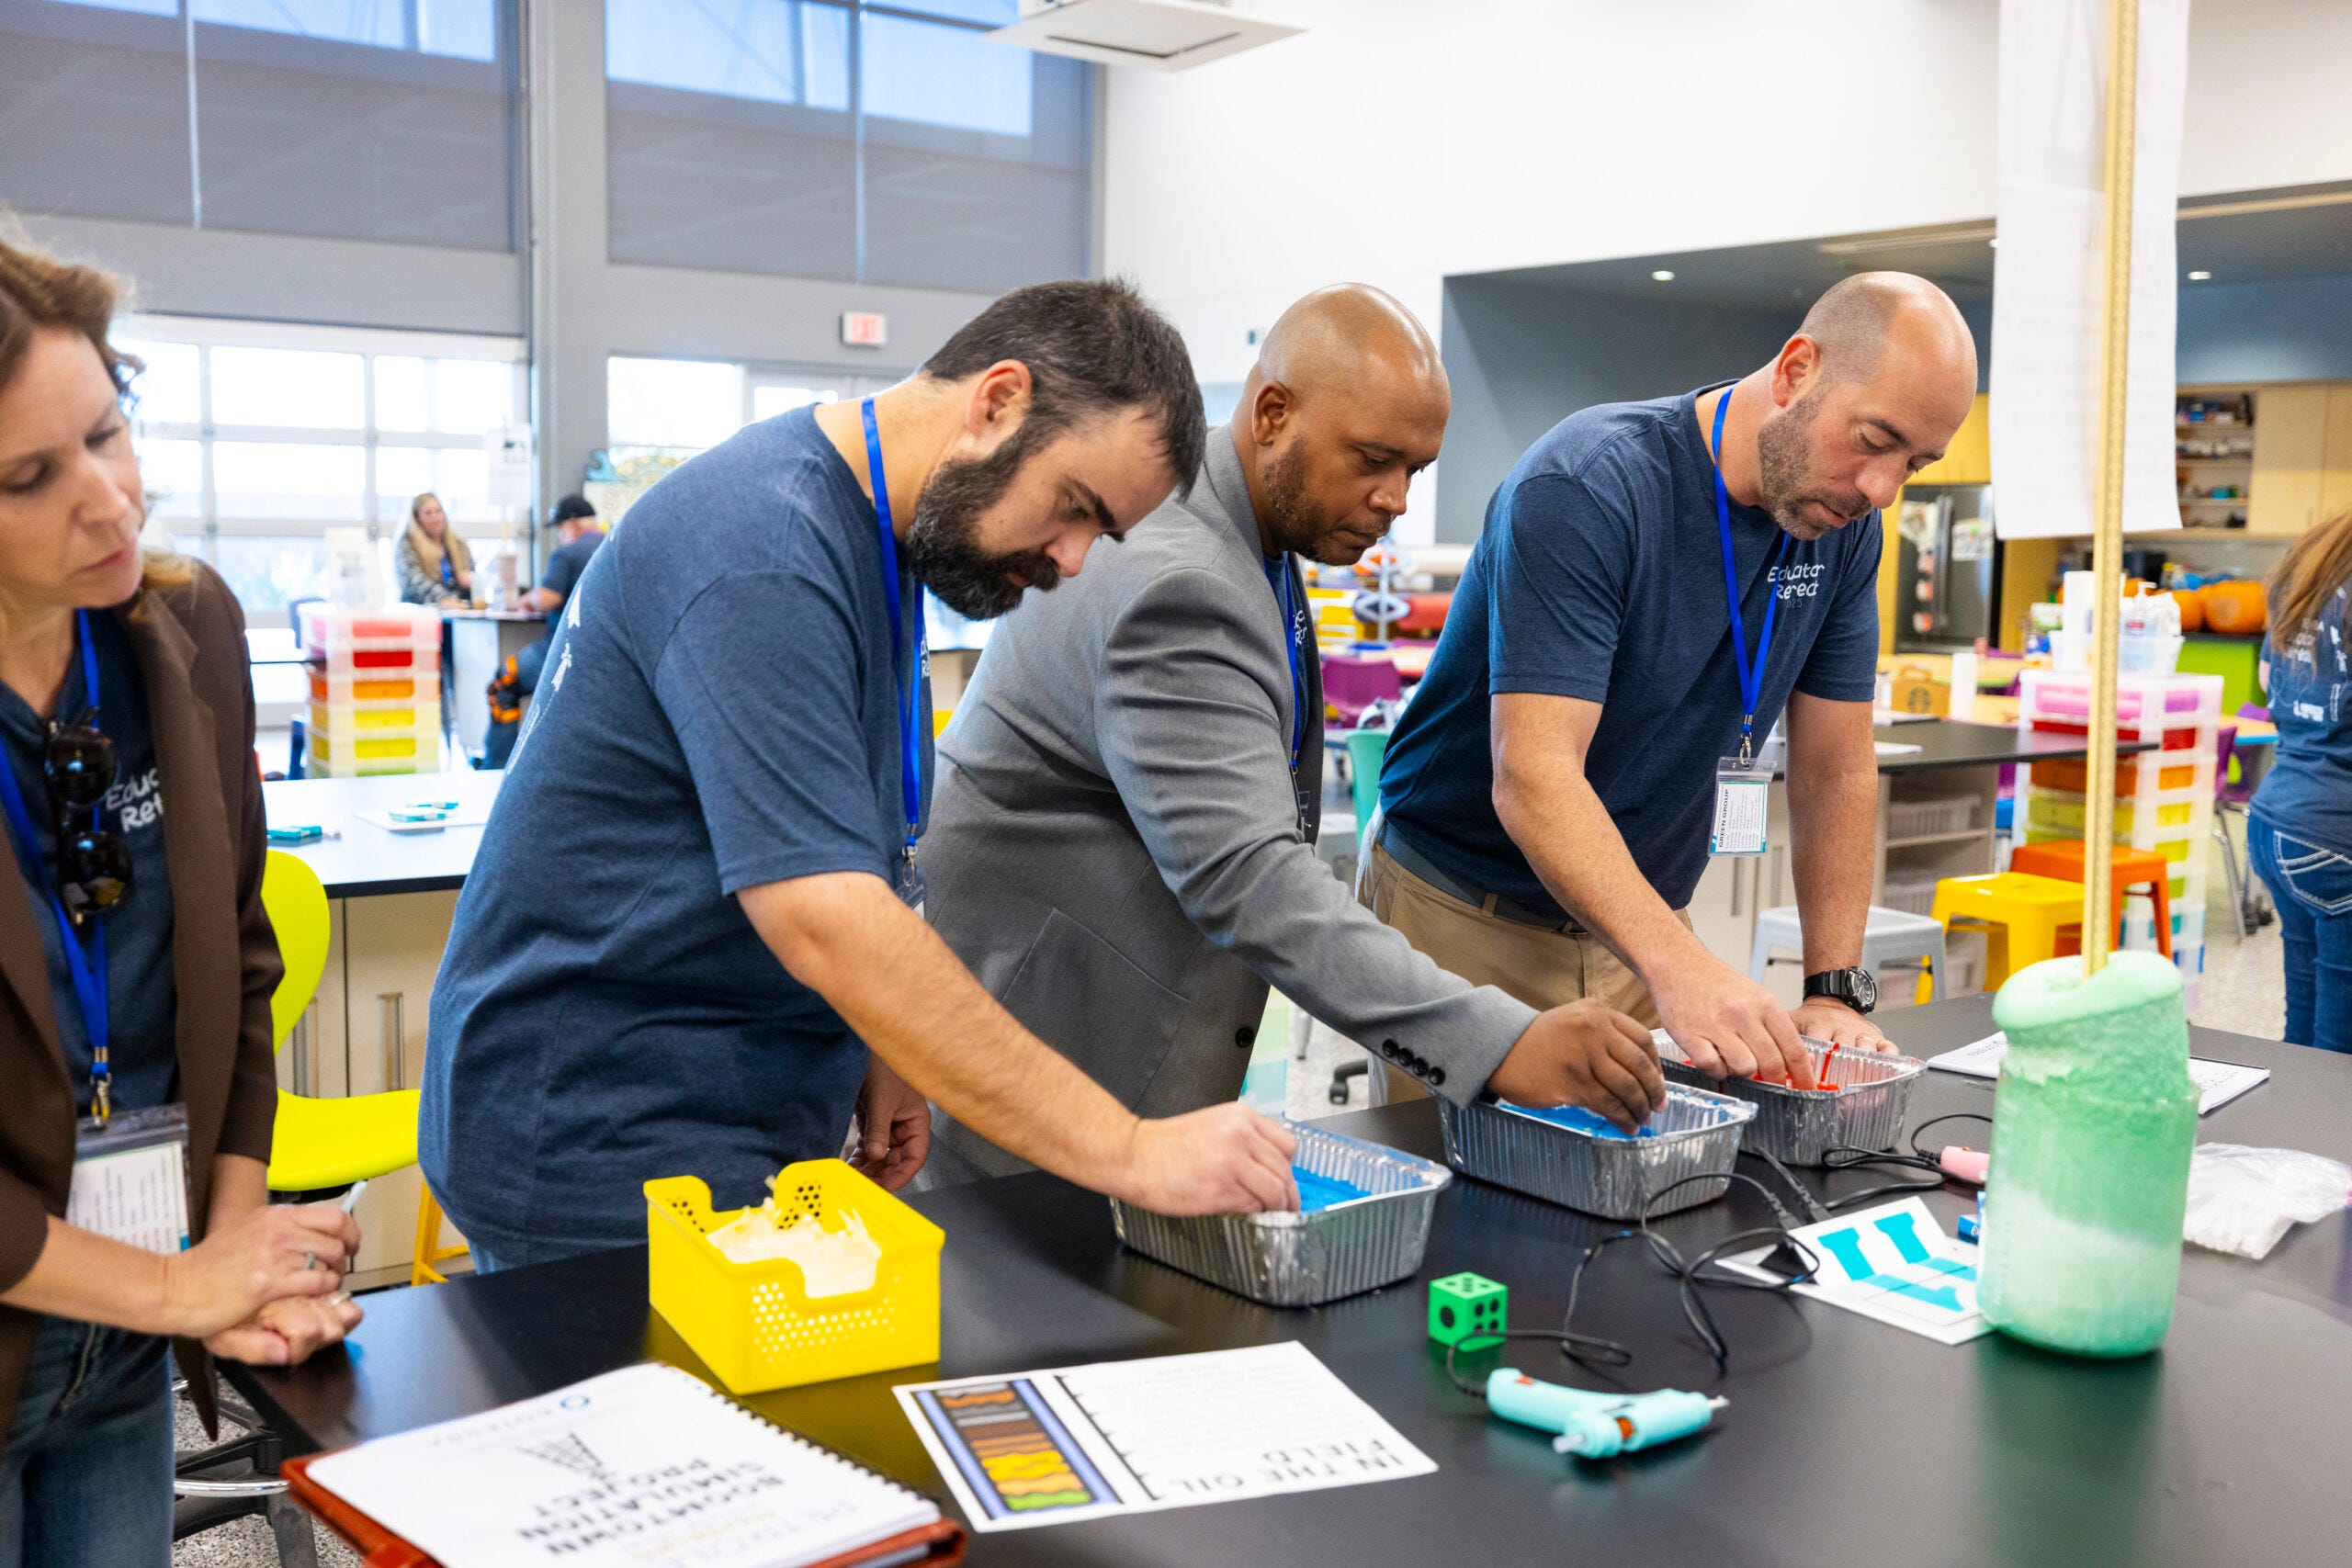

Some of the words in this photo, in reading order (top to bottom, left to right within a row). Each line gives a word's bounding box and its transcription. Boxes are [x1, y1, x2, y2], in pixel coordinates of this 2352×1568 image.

[1768, 563, 1826, 582] Eduator
[1262, 1438, 1386, 1462] FIELD
[1266, 1462, 1339, 1482] THE
[1356, 1453, 1405, 1471] IN
[533, 1458, 710, 1517] PROJECT
[1170, 1473, 1244, 1493] OIL
[517, 1462, 764, 1540] SIMULATION
